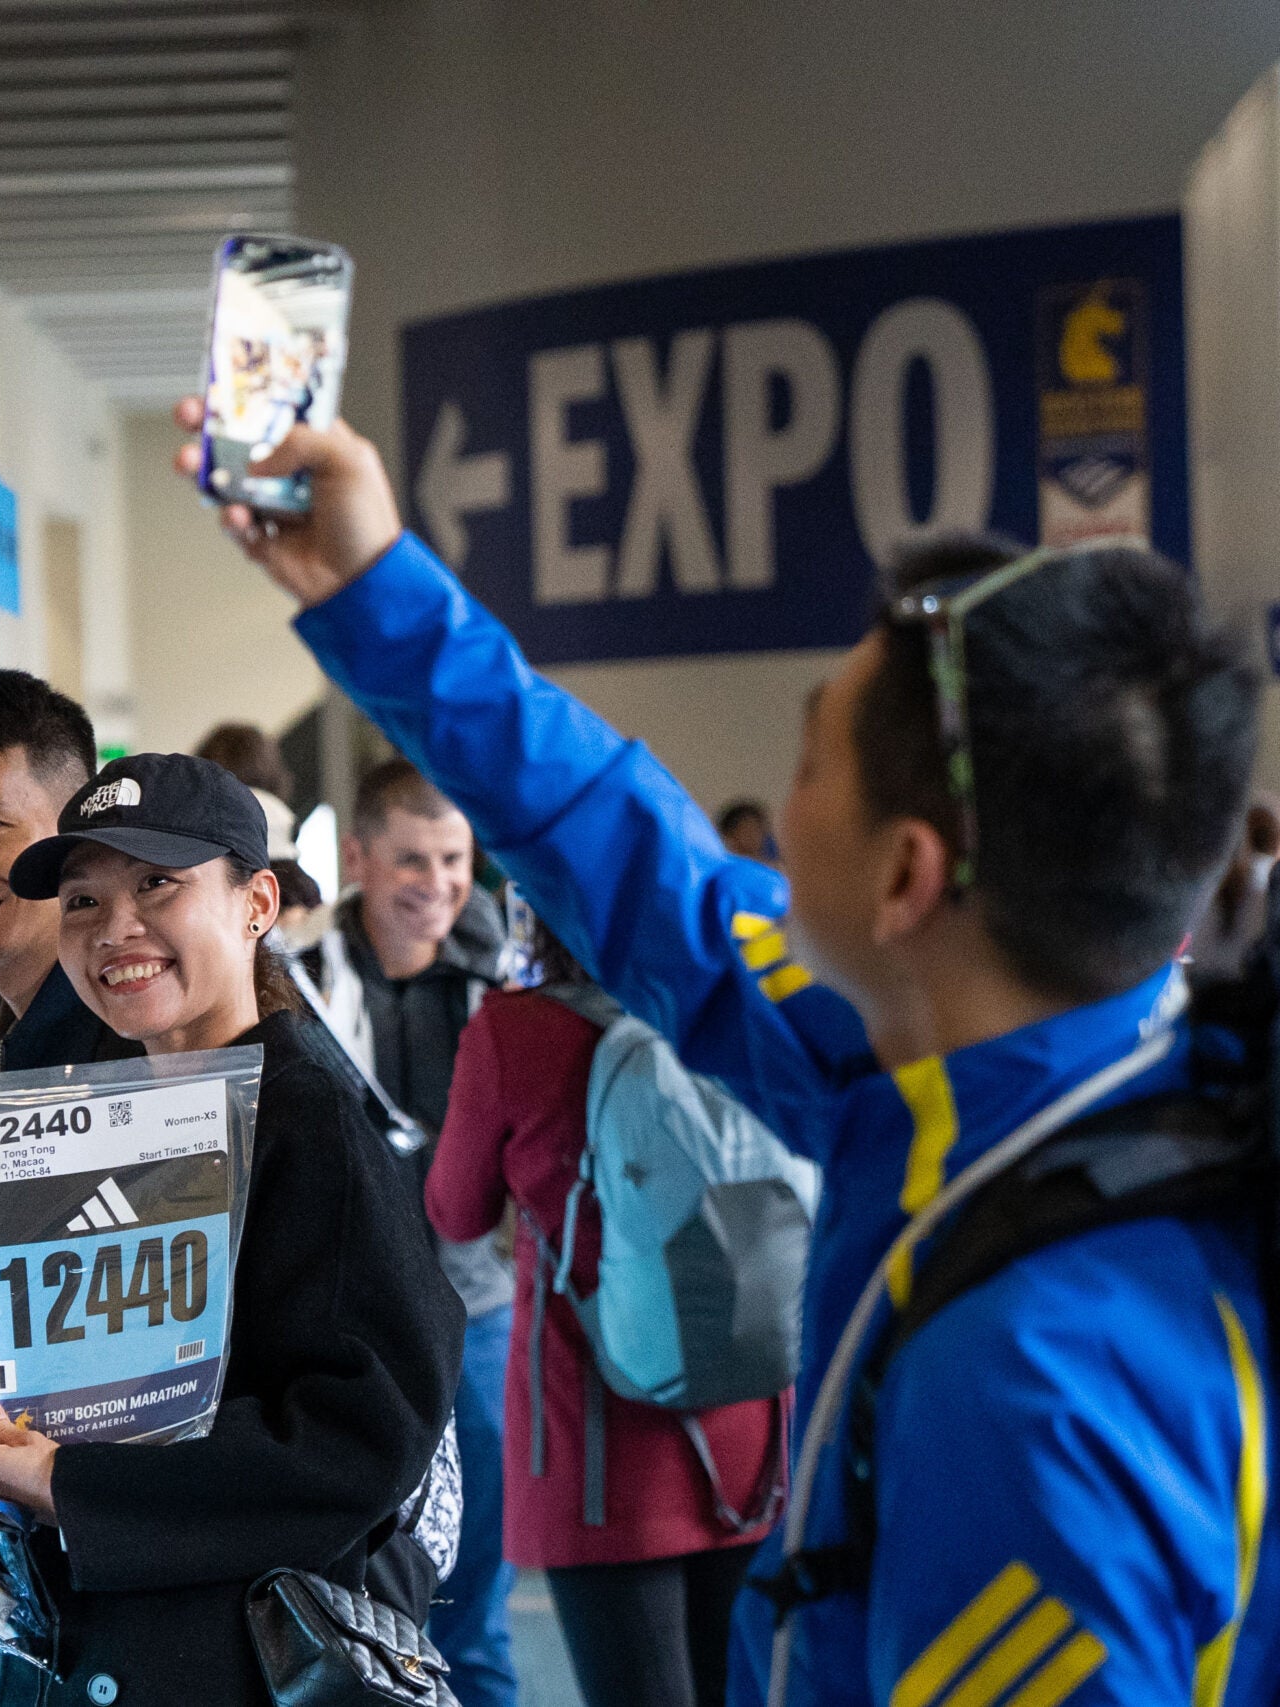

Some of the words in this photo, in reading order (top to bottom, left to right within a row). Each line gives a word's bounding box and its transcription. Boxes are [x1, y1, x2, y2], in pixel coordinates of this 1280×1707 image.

[528, 296, 996, 607] EXPO
[164, 1110, 218, 1127] Women-XS
[3, 1149, 28, 1159] Tong
[30, 1145, 56, 1155] Tong
[138, 1150, 162, 1161] Start
[164, 1146, 191, 1157] Time:
[192, 1139, 218, 1152] 10:28
[12, 1157, 45, 1168] Macao
[4, 1166, 52, 1180] 11-Oct-84
[74, 1397, 127, 1421] BOSTON
[129, 1378, 199, 1410] MARATHON
[45, 1427, 75, 1439] BANK
[76, 1423, 90, 1433] OF
[91, 1414, 136, 1431] AMERICA
